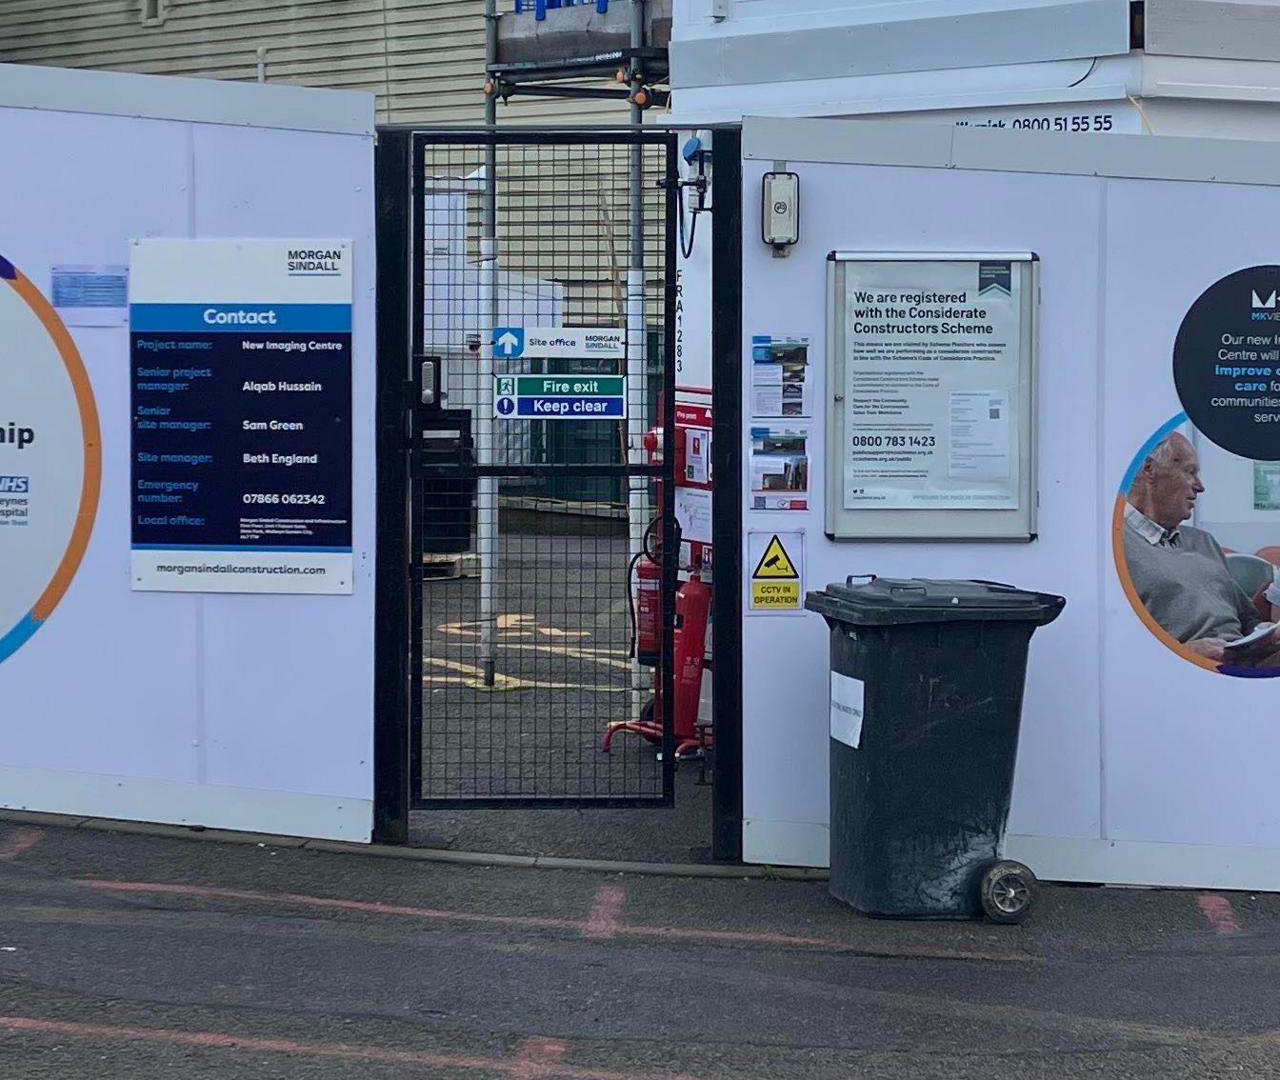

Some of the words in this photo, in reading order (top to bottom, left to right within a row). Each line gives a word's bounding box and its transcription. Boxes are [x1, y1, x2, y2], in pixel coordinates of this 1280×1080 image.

[1054, 117, 1068, 132] 51
[1071, 116, 1091, 132] 55
[1093, 115, 1113, 132] 55
[287, 250, 341, 260] MORGAN
[287, 261, 339, 271] SINDALL
[854, 292, 874, 304] We
[877, 294, 898, 304] are
[900, 292, 967, 306] registered
[203, 308, 278, 325] Contact
[854, 307, 882, 319] with
[885, 307, 906, 319] the
[908, 307, 987, 319] Considerate
[853, 322, 939, 334] Constructors
[941, 322, 994, 334] Scheme
[528, 339, 547, 347] Site
[549, 339, 576, 347] office
[1221, 333, 1244, 345] Our
[1246, 336, 1271, 345] new
[137, 340, 175, 352] Project
[178, 342, 213, 350] name:
[242, 341, 264, 350] New
[266, 341, 307, 352] Imaging
[308, 341, 343, 350] Centre
[1217, 348, 1258, 360] Centre
[1260, 350, 1279, 360] will
[278, 381, 322, 391] Hussain
[543, 380, 570, 393] Fire
[573, 380, 599, 393] exit
[1234, 382, 1268, 392] care
[533, 400, 569, 414] Keep
[573, 400, 608, 412] clear
[242, 420, 267, 430] Sam
[269, 420, 304, 430] Green
[852, 435, 883, 447] 0800
[884, 435, 906, 447] 783
[908, 435, 936, 447] 1423
[137, 452, 158, 462] Site
[243, 454, 270, 464] Beth
[272, 454, 318, 466] England
[243, 494, 279, 504] 07866
[281, 495, 326, 504] 062342
[156, 563, 326, 575] morgansindallconstruction.com
[760, 586, 781, 594] CCTV
[754, 596, 798, 604] OPERATION
